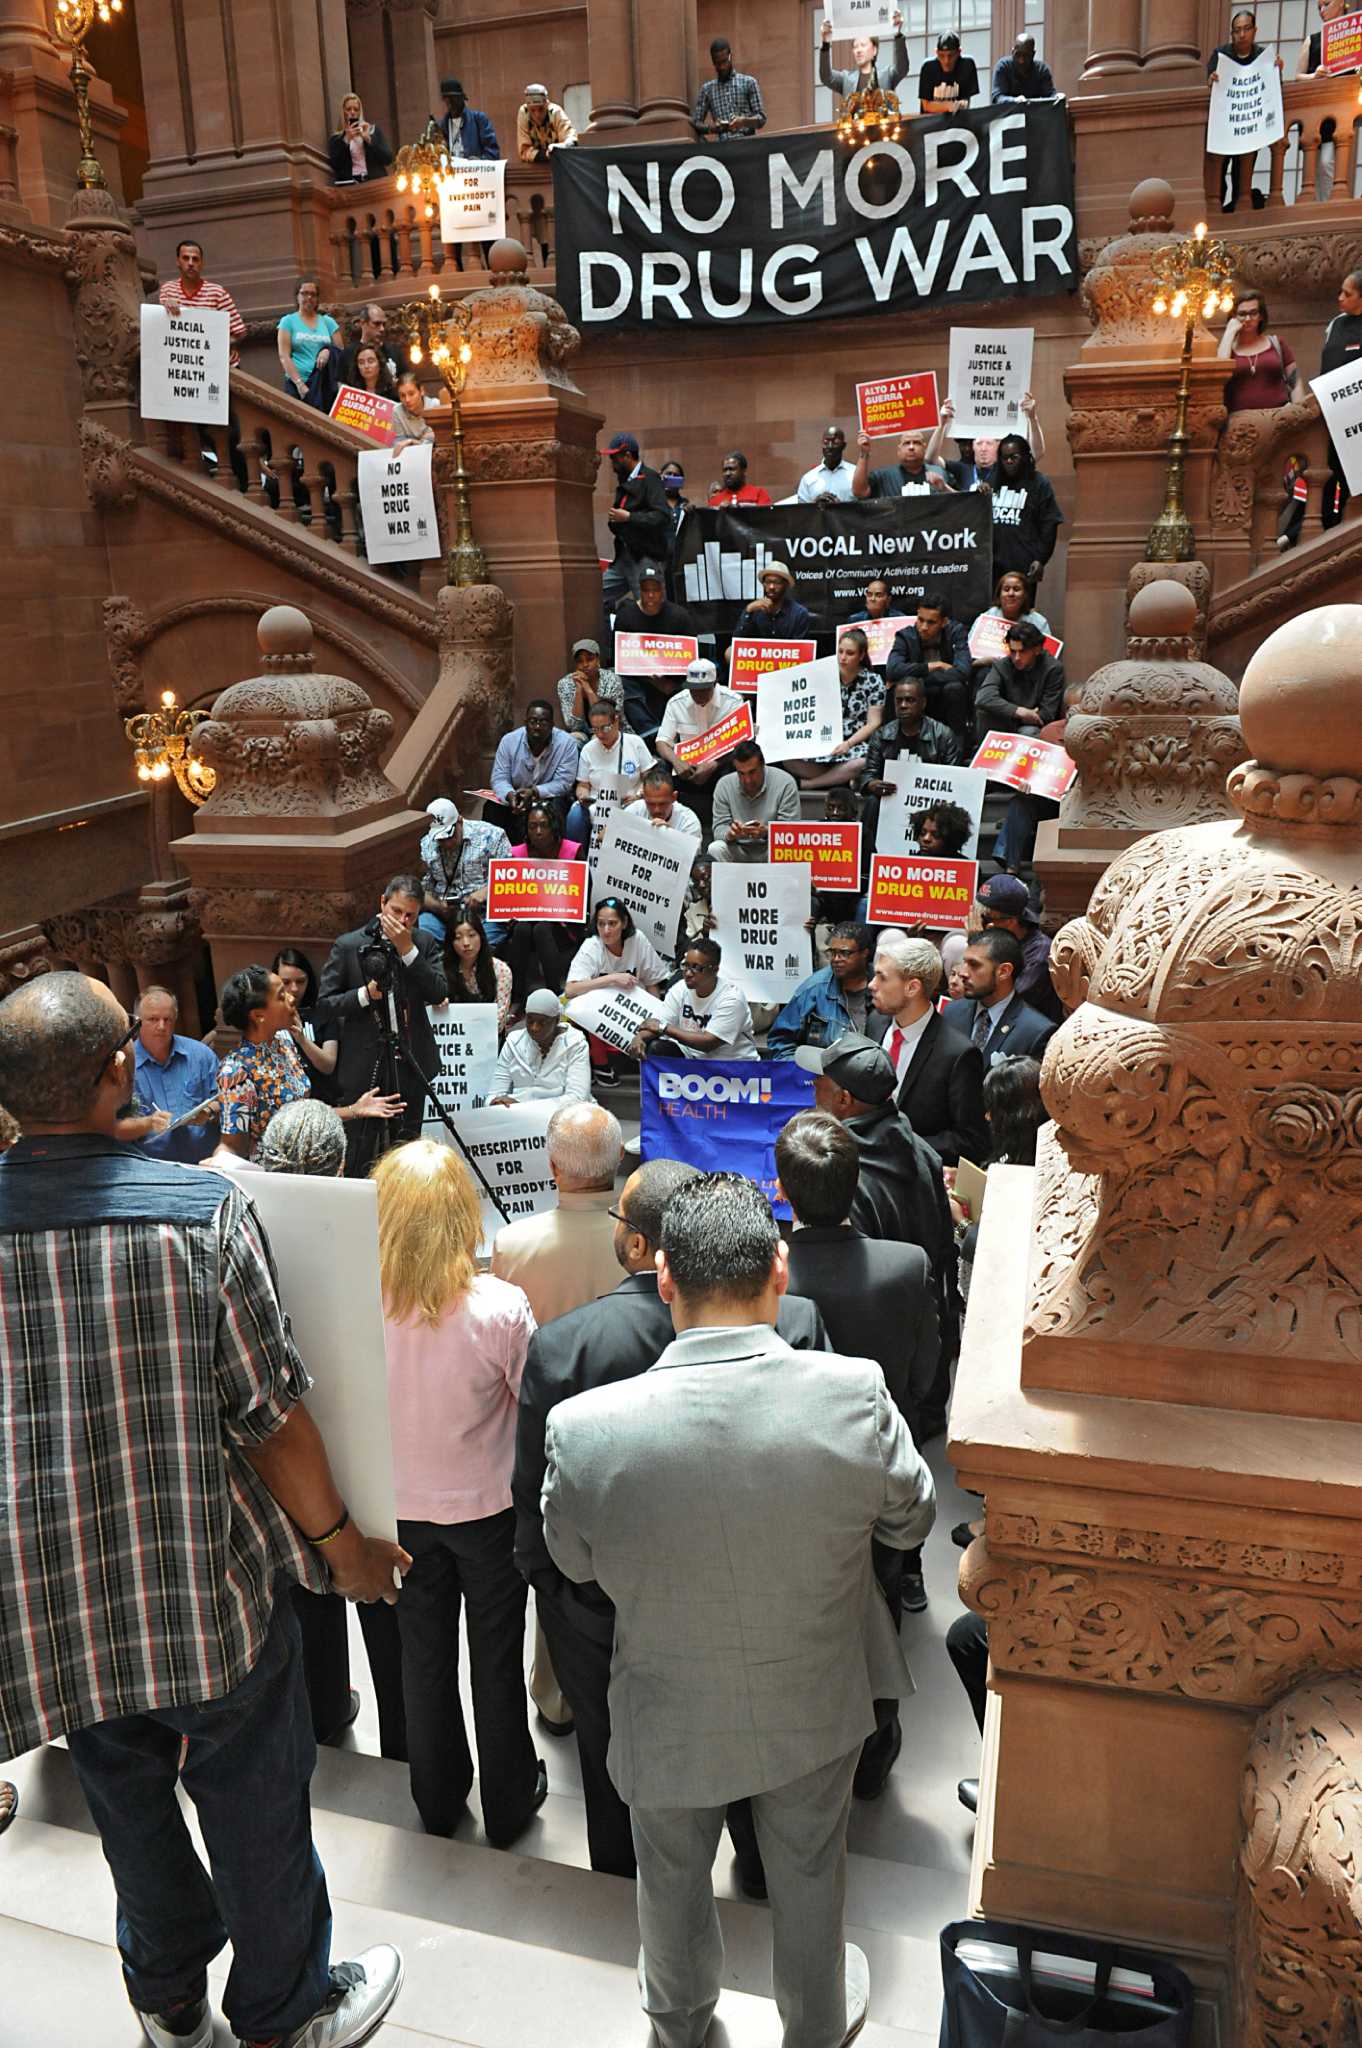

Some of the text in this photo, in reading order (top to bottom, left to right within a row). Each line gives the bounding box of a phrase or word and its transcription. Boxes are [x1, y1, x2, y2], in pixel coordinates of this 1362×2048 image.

[850, 0, 871, 10] PAIN
[1328, 20, 1348, 34] ALTO
[1232, 72, 1261, 86] RACIAL
[1226, 87, 1258, 99] JUSTICE
[1232, 98, 1262, 111] PUBLIC
[1229, 110, 1263, 123] HEALTH
[1234, 124, 1258, 136] NOW!
[605, 112, 1028, 236] NO MORE
[464, 178, 479, 187] FOR
[464, 204, 481, 212] PAIN
[578, 204, 1074, 322] DRUG WAR
[170, 320, 205, 333] RACIAL
[163, 336, 210, 350] JUSTICE &
[974, 344, 1007, 355] RACIAL
[170, 353, 204, 366] PUBLIC
[968, 360, 1011, 370] JUSTICE &
[168, 368, 205, 382] HEALTH
[973, 376, 1005, 386] PUBLIC
[173, 386, 199, 399] NOW!
[864, 385, 888, 396] ALTO
[898, 381, 911, 390] LA
[970, 389, 1005, 400] HEALTH
[344, 392, 387, 412] ALTO A LA
[865, 393, 903, 404] GUERRA
[866, 397, 924, 414] CONTRA LAS
[342, 400, 376, 416] GUERRA
[974, 406, 998, 417] NOW!
[866, 410, 905, 423] DROGAS
[387, 462, 401, 476] NO
[381, 482, 410, 498] MORE
[384, 499, 410, 514] DRUG
[992, 508, 1021, 520] OCAL
[388, 521, 410, 535] WAR
[785, 528, 977, 558] VOCAL New York
[795, 563, 968, 580] Voices Of Community Activists & Leaders
[622, 640, 682, 649] NO MORE
[664, 650, 692, 659] WAR
[737, 647, 800, 659] NO MORE
[736, 660, 775, 671] DRUG
[792, 678, 807, 692] NO
[784, 696, 816, 712] MORE
[784, 710, 816, 725] DRUG
[681, 742, 700, 754] NO
[704, 716, 738, 744] MORE
[681, 739, 717, 761] DRUG
[720, 719, 747, 741] WAR
[786, 729, 812, 740] WAR
[989, 740, 1012, 750] NO
[915, 777, 953, 792] RACIAL
[774, 832, 842, 846] NO MORE
[614, 838, 680, 873] PRESCRIPTION
[774, 848, 853, 862] DRUG WAR
[495, 868, 568, 880] NO MORE
[631, 864, 652, 882] FOR
[878, 865, 957, 883] NO MORE
[494, 882, 579, 896] DRUG WAR
[606, 875, 670, 908] EVERYBODY'S
[747, 882, 767, 898] NO
[876, 881, 924, 898] DRUG
[929, 886, 968, 901] WAR
[623, 899, 647, 914] PAIN
[739, 908, 778, 924] MORE
[740, 929, 778, 945] DRUG
[744, 954, 774, 970] WAR
[432, 1024, 465, 1036] ACIAL
[465, 1043, 473, 1056] &
[440, 1064, 466, 1076] BLIC
[430, 1082, 467, 1095] EALTH
[659, 1072, 772, 1104] BOOM!
[659, 1102, 726, 1120] HEALTH
[496, 1160, 523, 1176] FOR
[503, 1200, 534, 1214] PAIN
